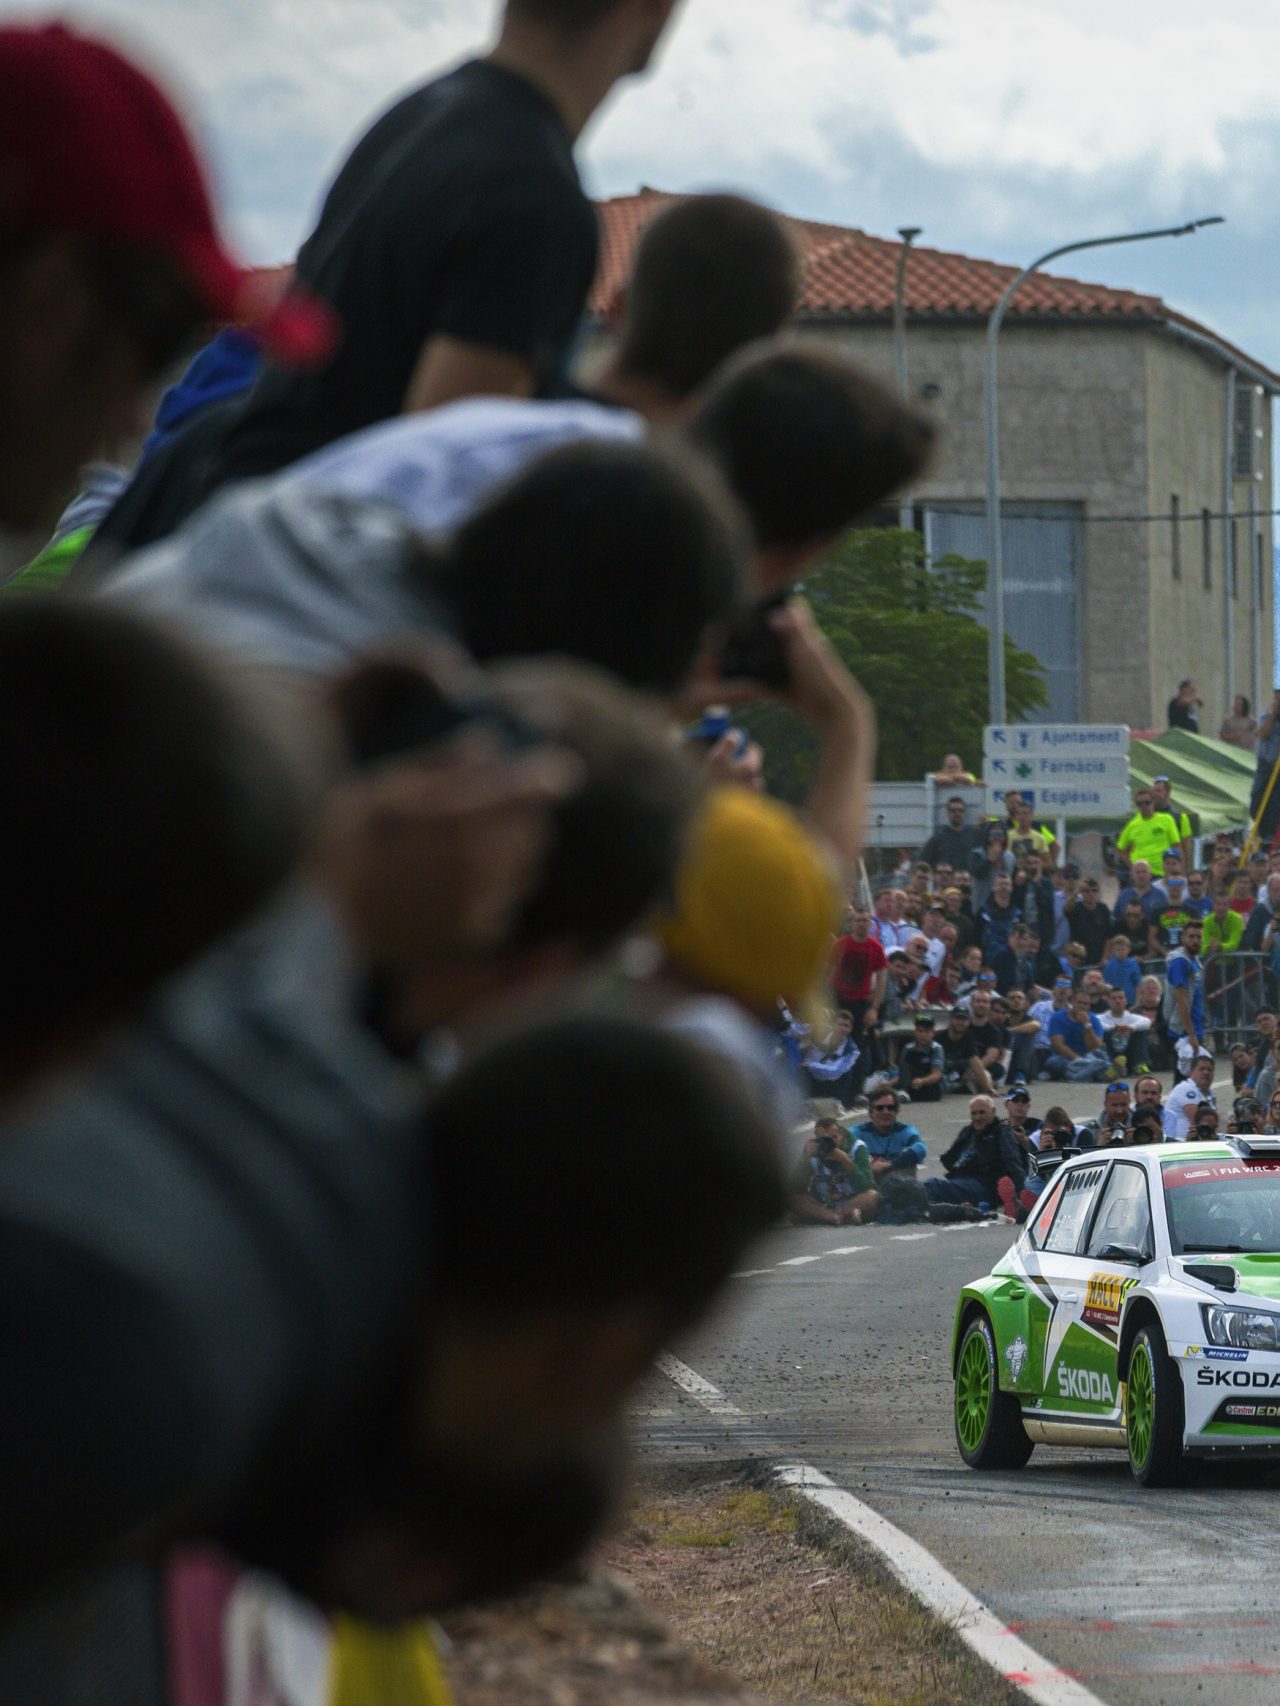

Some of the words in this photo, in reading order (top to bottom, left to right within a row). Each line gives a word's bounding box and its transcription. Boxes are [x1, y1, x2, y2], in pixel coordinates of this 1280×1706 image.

[1041, 731, 1120, 747] Ajuntament
[1220, 1167, 1241, 1175] FIA
[1242, 1165, 1270, 1174] WRC
[1089, 1274, 1120, 1308] RACC
[1208, 1350, 1248, 1359] MICHELIN
[1057, 1360, 1114, 1403] ŠKODA
